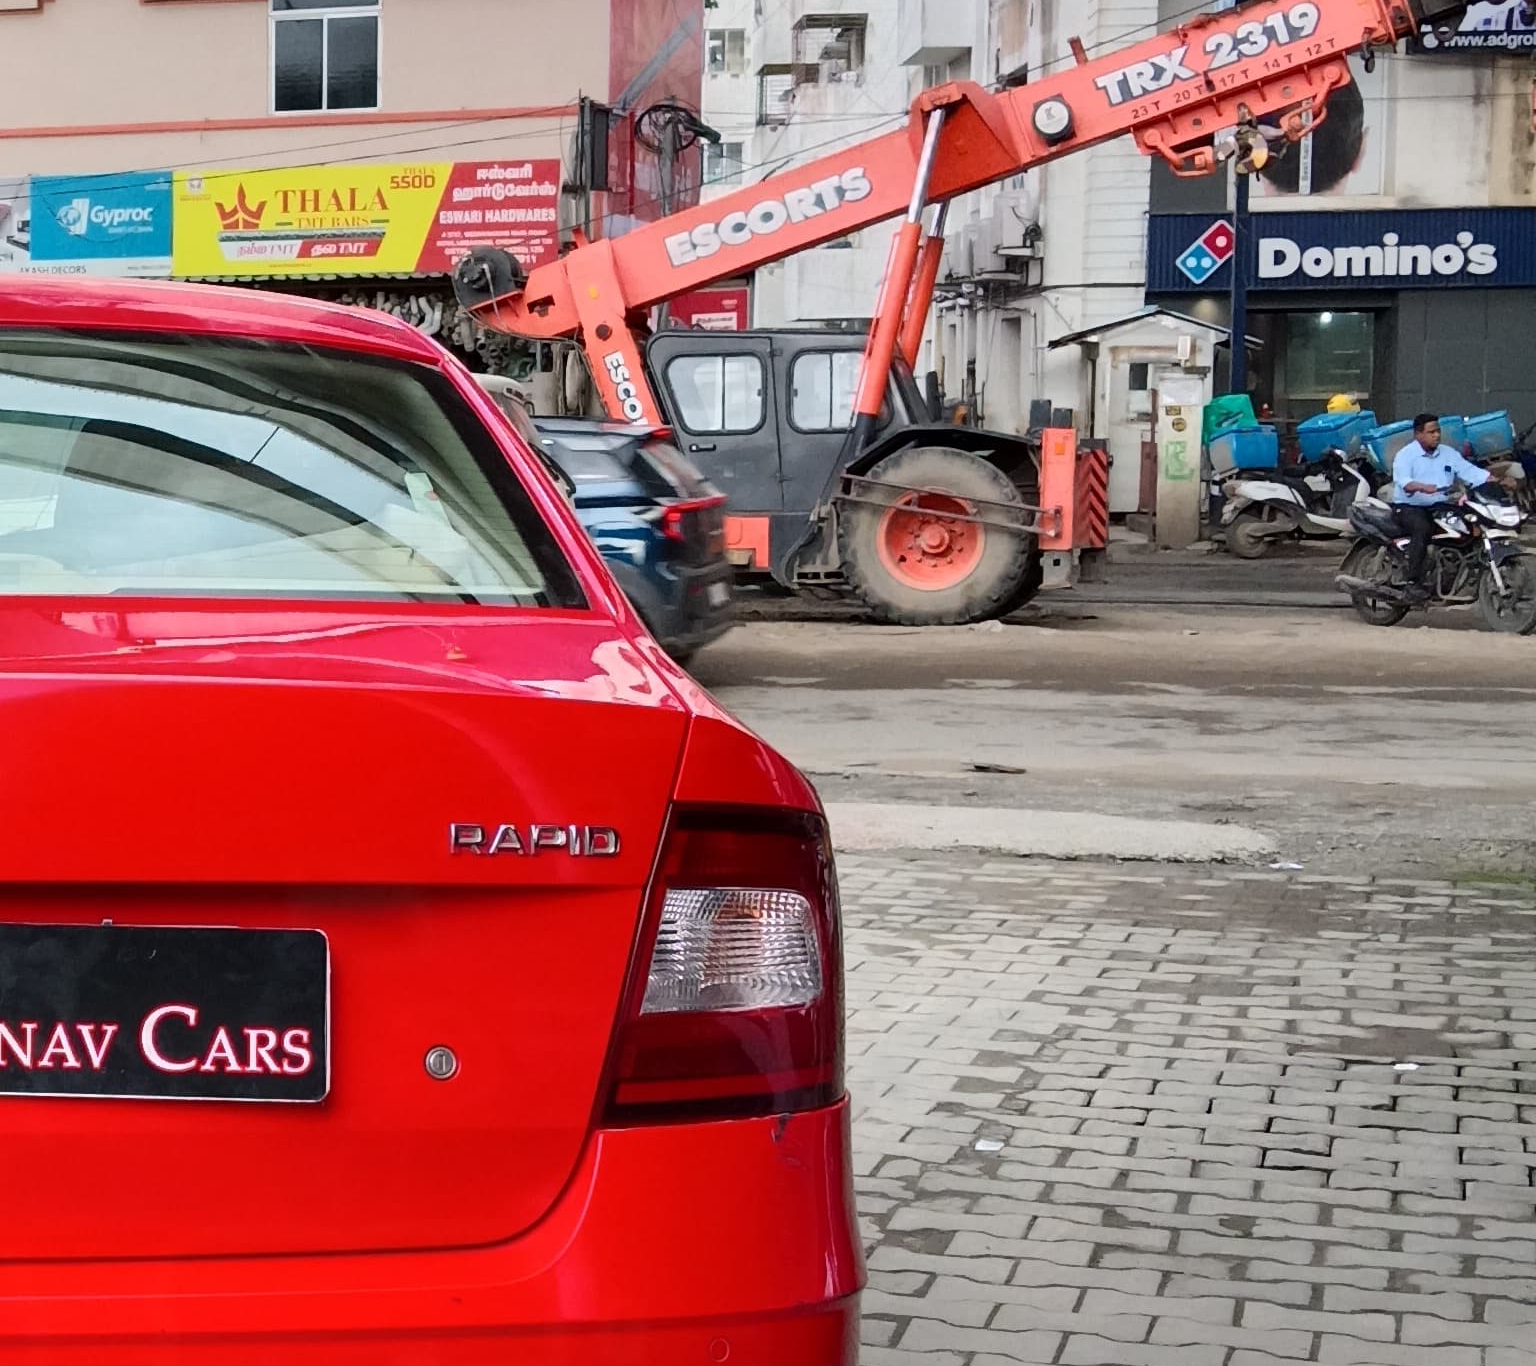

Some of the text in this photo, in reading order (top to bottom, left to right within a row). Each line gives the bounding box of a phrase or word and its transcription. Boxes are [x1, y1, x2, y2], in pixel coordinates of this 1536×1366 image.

[1095, 2, 1321, 105] TRX 2319
[1444, 31, 1536, 49] www.adgro
[1131, 107, 1149, 120] 23
[1175, 90, 1192, 104] 20
[1219, 74, 1237, 88] 17
[1264, 58, 1280, 73] 14
[1305, 44, 1323, 56] 12
[275, 187, 389, 214] THALA
[90, 205, 154, 227] Gyproc
[439, 208, 556, 224] ESWARI HARDWARES
[665, 167, 872, 268] ESCORTS
[51, 266, 87, 274] DECORS
[1258, 231, 1498, 279] Domino's
[449, 823, 620, 856] RAPID
